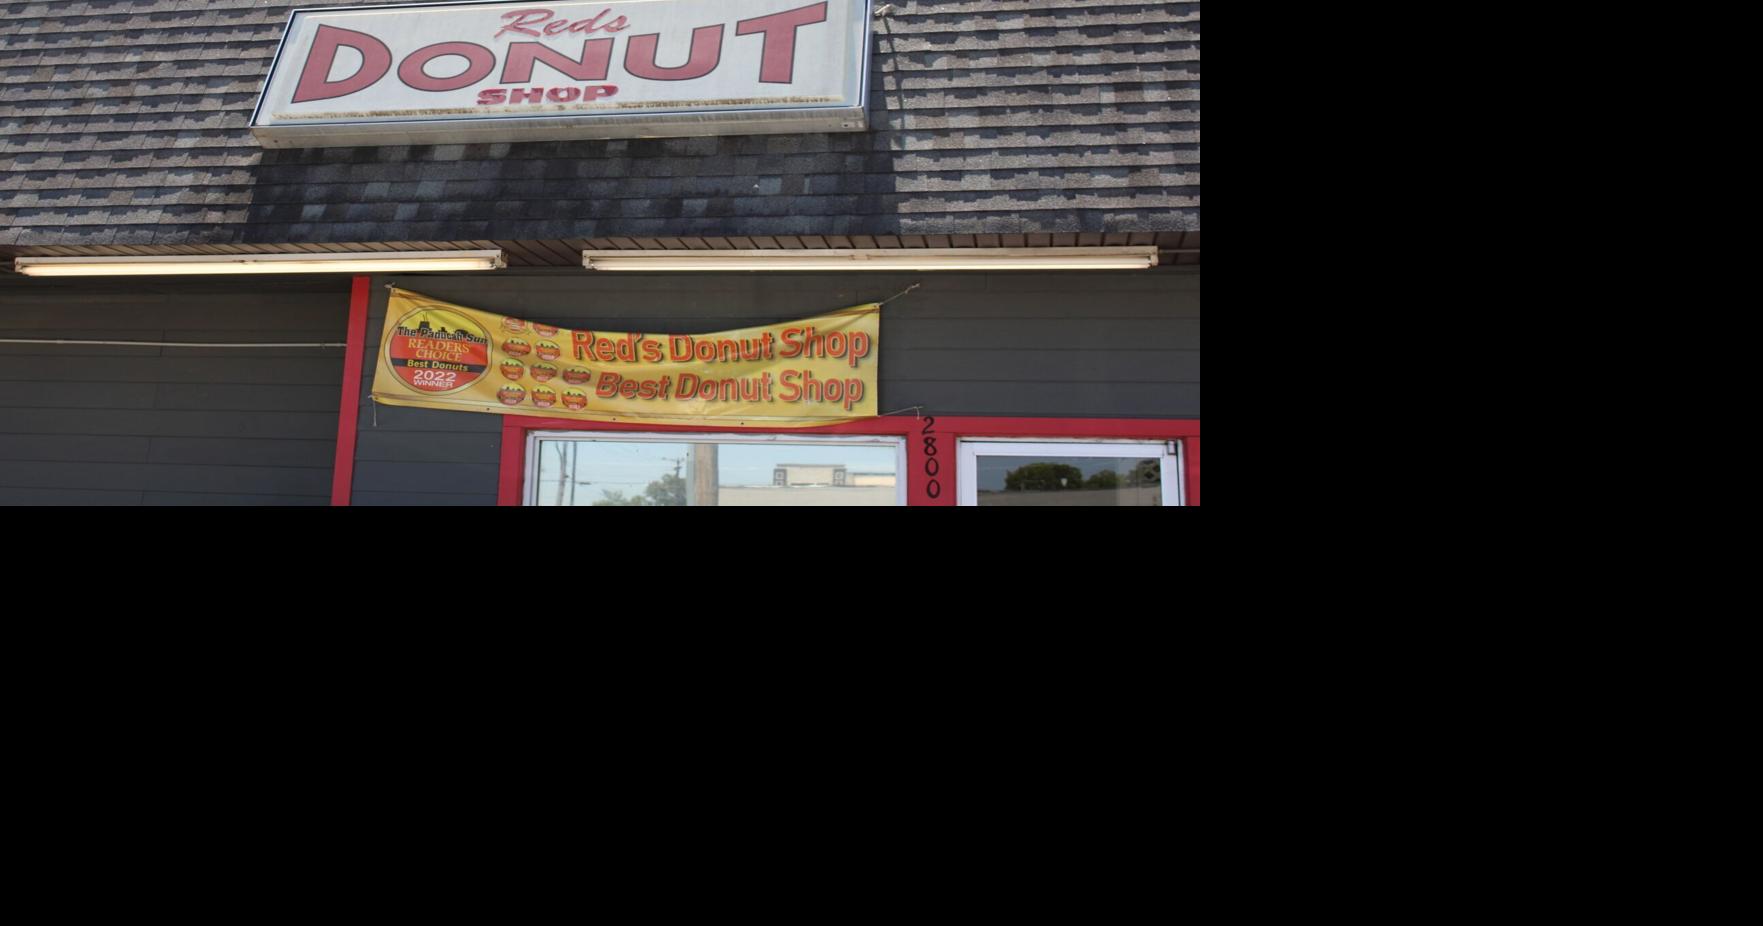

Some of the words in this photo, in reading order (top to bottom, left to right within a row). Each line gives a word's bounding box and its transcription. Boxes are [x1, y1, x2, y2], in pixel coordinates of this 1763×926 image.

[494, 8, 631, 39] Reds
[290, 1, 827, 104] DONUT
[476, 84, 619, 105] SHOP
[397, 326, 417, 337] The
[467, 333, 488, 344] Sun
[408, 338, 470, 353] READERS
[415, 348, 463, 361] CHOICE
[571, 328, 663, 362] Red's
[668, 331, 775, 363] Donut
[780, 327, 870, 367] Shop
[407, 359, 429, 369] Best
[432, 361, 469, 372] Donuts
[414, 369, 457, 382] 2022
[414, 379, 454, 389] WINNER
[595, 371, 671, 399] Best
[675, 371, 773, 402] Donut
[779, 369, 864, 411] Shop
[921, 416, 941, 499] 2800
